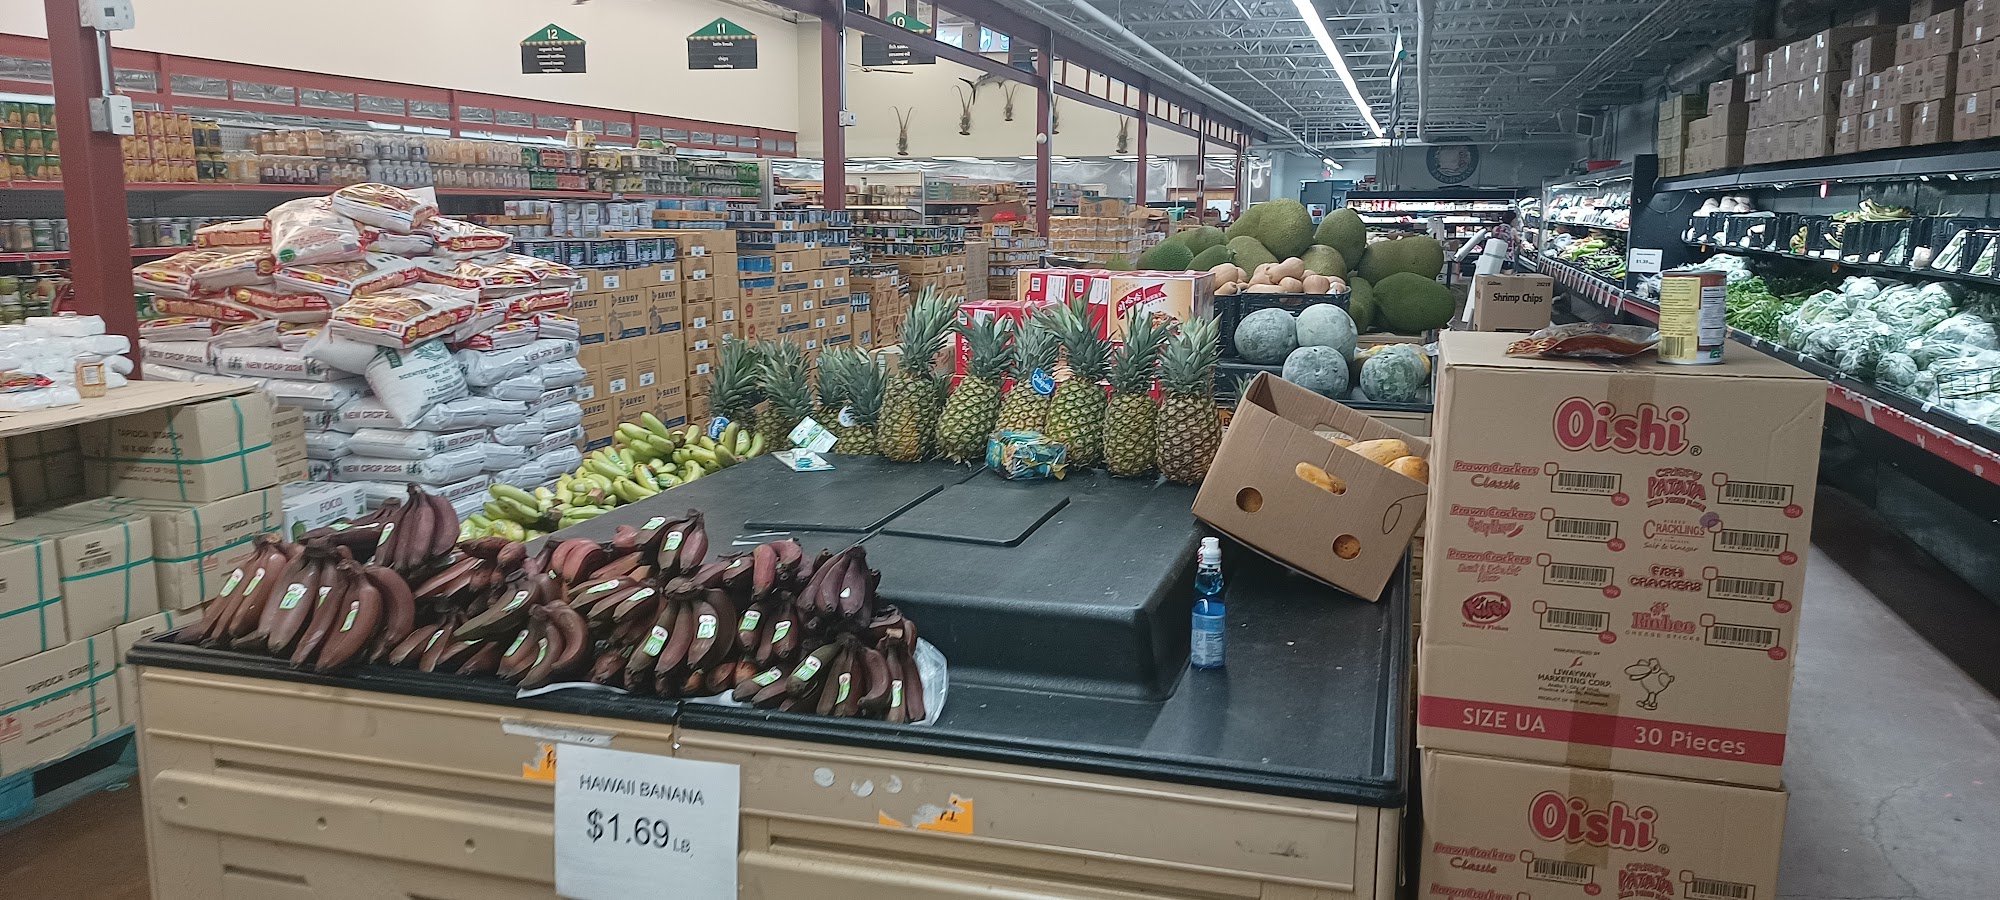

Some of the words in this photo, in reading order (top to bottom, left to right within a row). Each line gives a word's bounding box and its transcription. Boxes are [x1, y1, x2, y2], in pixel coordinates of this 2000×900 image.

[716, 24, 726, 34] 11
[892, 17, 905, 28] 10
[547, 29, 558, 40] 12
[575, 300, 598, 308] SAVOY
[618, 294, 638, 303] SAVOY
[1493, 293, 1520, 304] Shrimp
[1522, 293, 1543, 304] Chips
[165, 352, 184, 360] CROP
[262, 362, 283, 370] CROP
[663, 386, 680, 396] SAVOY
[626, 395, 645, 406] SAVOY
[584, 404, 605, 415] SAVOY
[1553, 396, 1690, 456] Oishi
[1453, 460, 1490, 474] Prawn
[1490, 462, 1539, 476] Crackers
[1471, 474, 1520, 490] Classic
[1648, 476, 1706, 500] PATATA
[320, 497, 343, 513] FOCO
[1450, 504, 1487, 518] Prawn
[1487, 506, 1536, 520] Crackers
[1643, 520, 1705, 539] CRACKLINGS
[1447, 548, 1484, 562] Prawn
[1484, 551, 1532, 565] Crackers
[1650, 564, 1684, 578] FISH
[1628, 575, 1702, 592] CRACKERS
[1538, 674, 1586, 684] MARKETING
[1588, 679, 1612, 688] CORP.
[1553, 668, 1596, 678] LIWAYWAY
[25, 675, 64, 694] TAPIOCA
[1462, 707, 1507, 729] SIZE
[1515, 713, 1546, 733] UA
[1634, 726, 1662, 745] 30
[1671, 730, 1746, 755] Pieces
[580, 774, 635, 796] HAWAII
[640, 782, 704, 805] BANANA
[586, 808, 669, 849] $1.69
[1528, 790, 1658, 852] Oishi
[1450, 857, 1498, 874] Classic
[1618, 869, 1674, 896] PATATA
